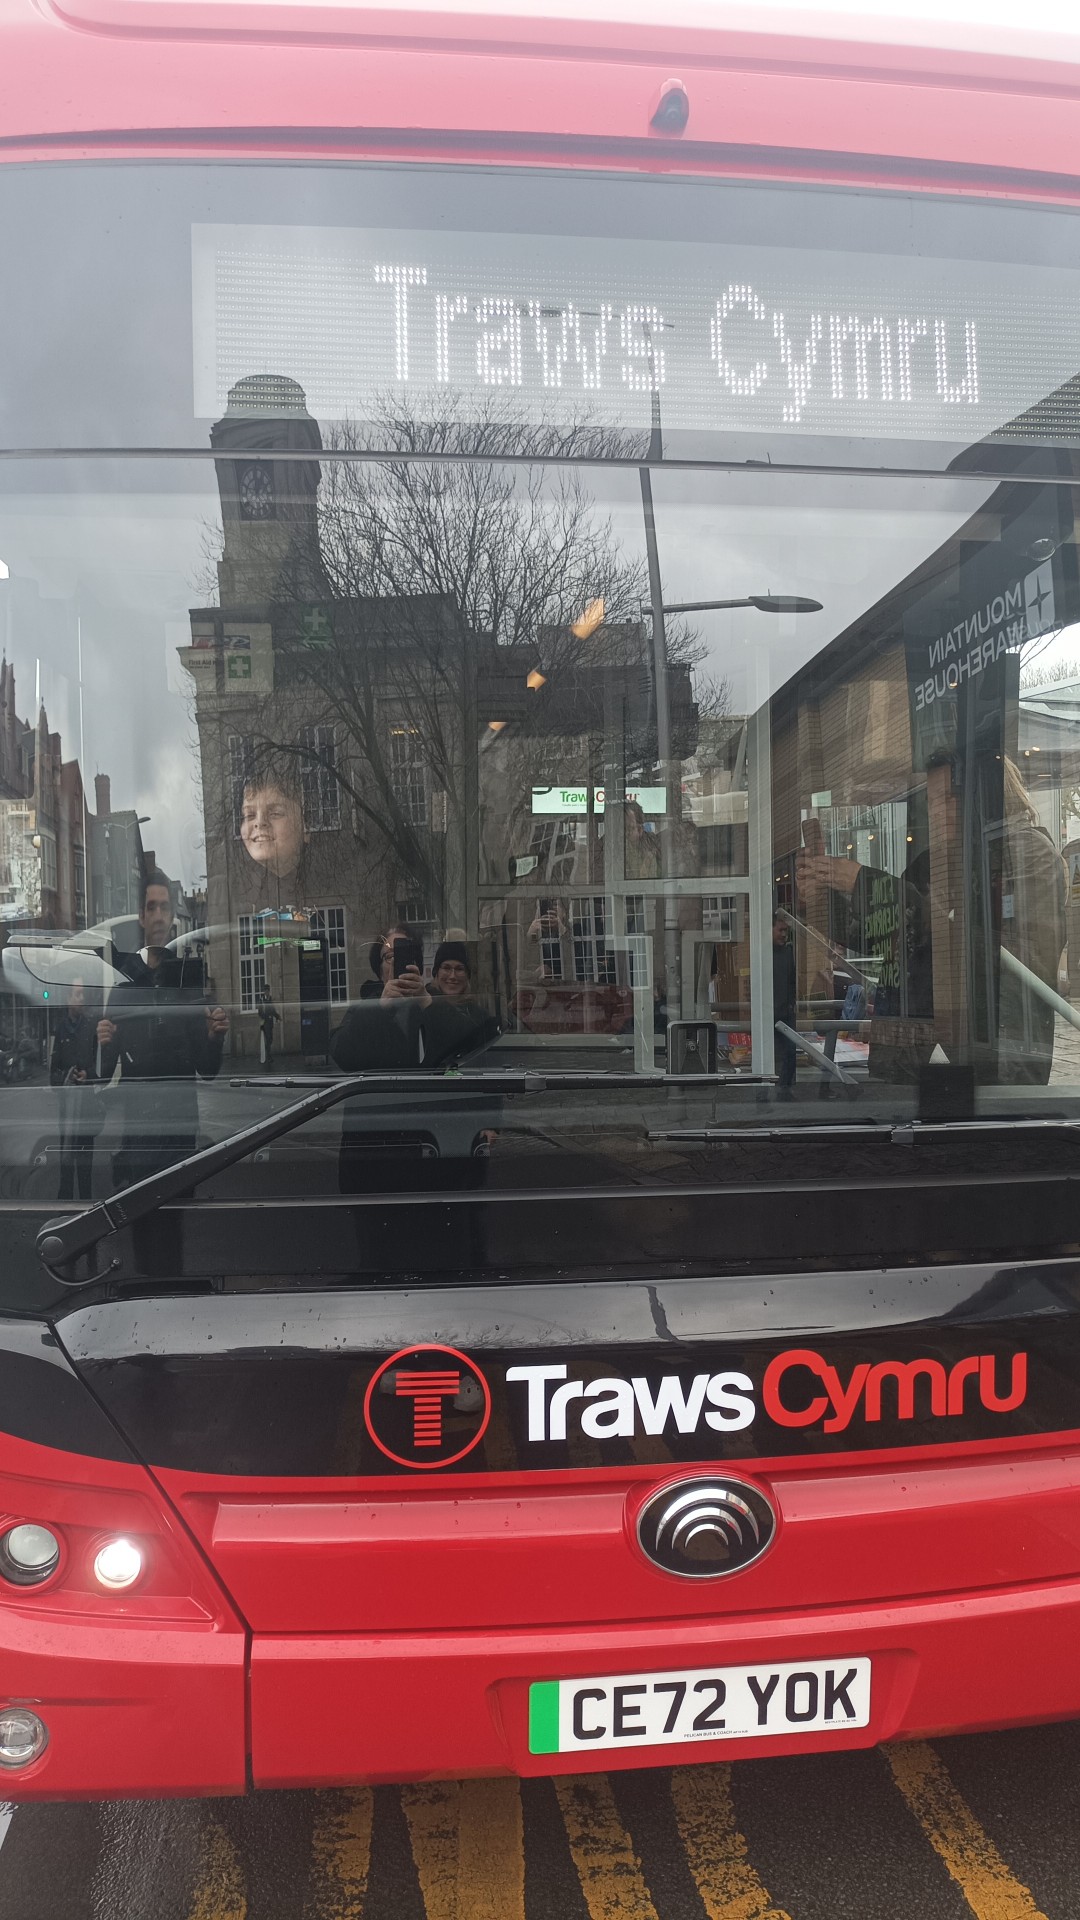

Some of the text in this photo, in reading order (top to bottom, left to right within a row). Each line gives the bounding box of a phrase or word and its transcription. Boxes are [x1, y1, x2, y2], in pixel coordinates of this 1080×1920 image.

[374, 264, 980, 424] Traws Cymru
[572, 1668, 858, 1741] CE72 YOK
